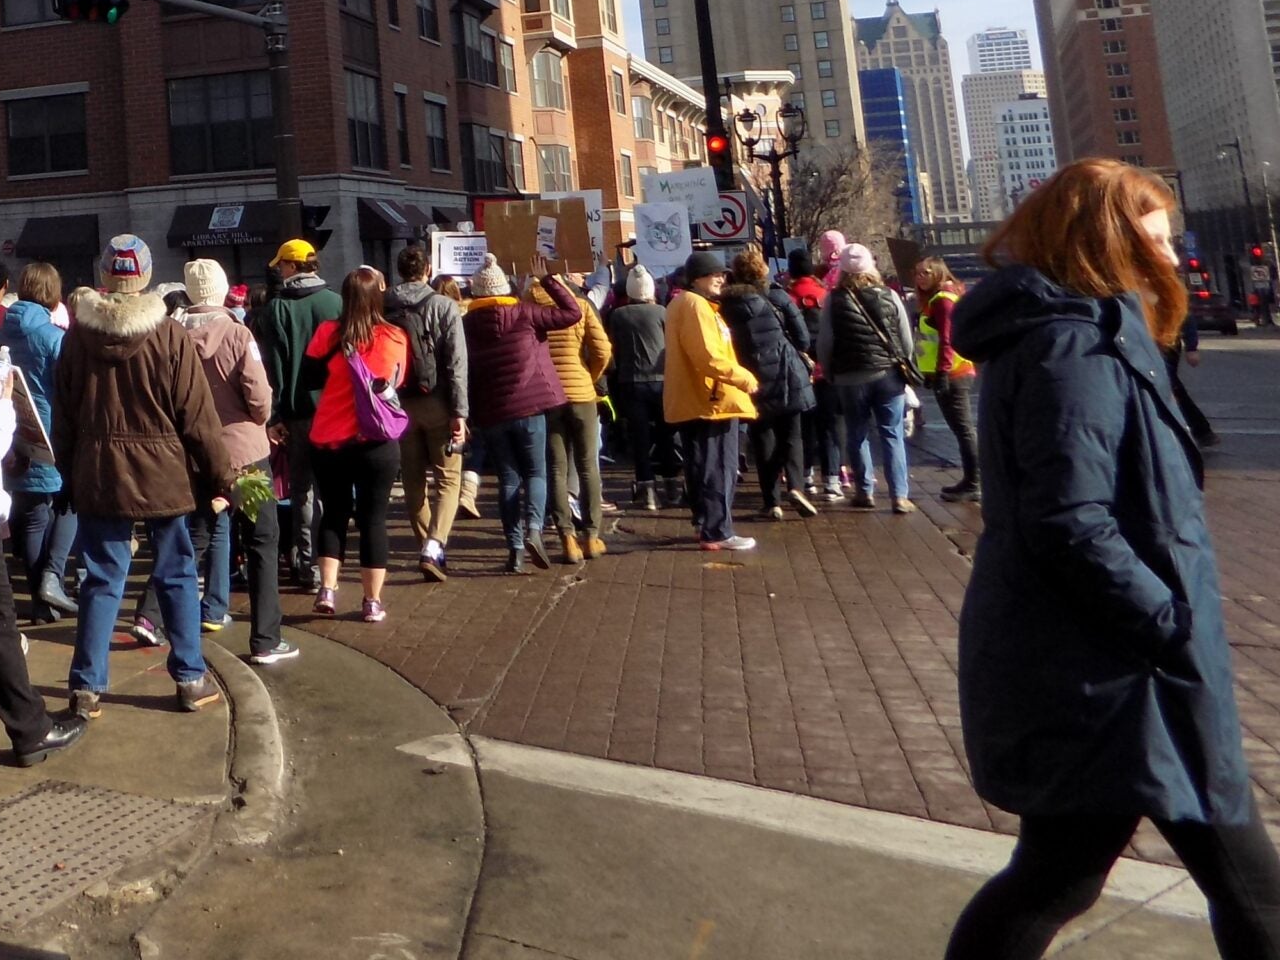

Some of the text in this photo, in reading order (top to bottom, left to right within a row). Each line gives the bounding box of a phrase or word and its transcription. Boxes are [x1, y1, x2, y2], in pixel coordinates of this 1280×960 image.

[192, 232, 228, 241] LIBRARY
[181, 236, 264, 248] APARTMENT HOMES
